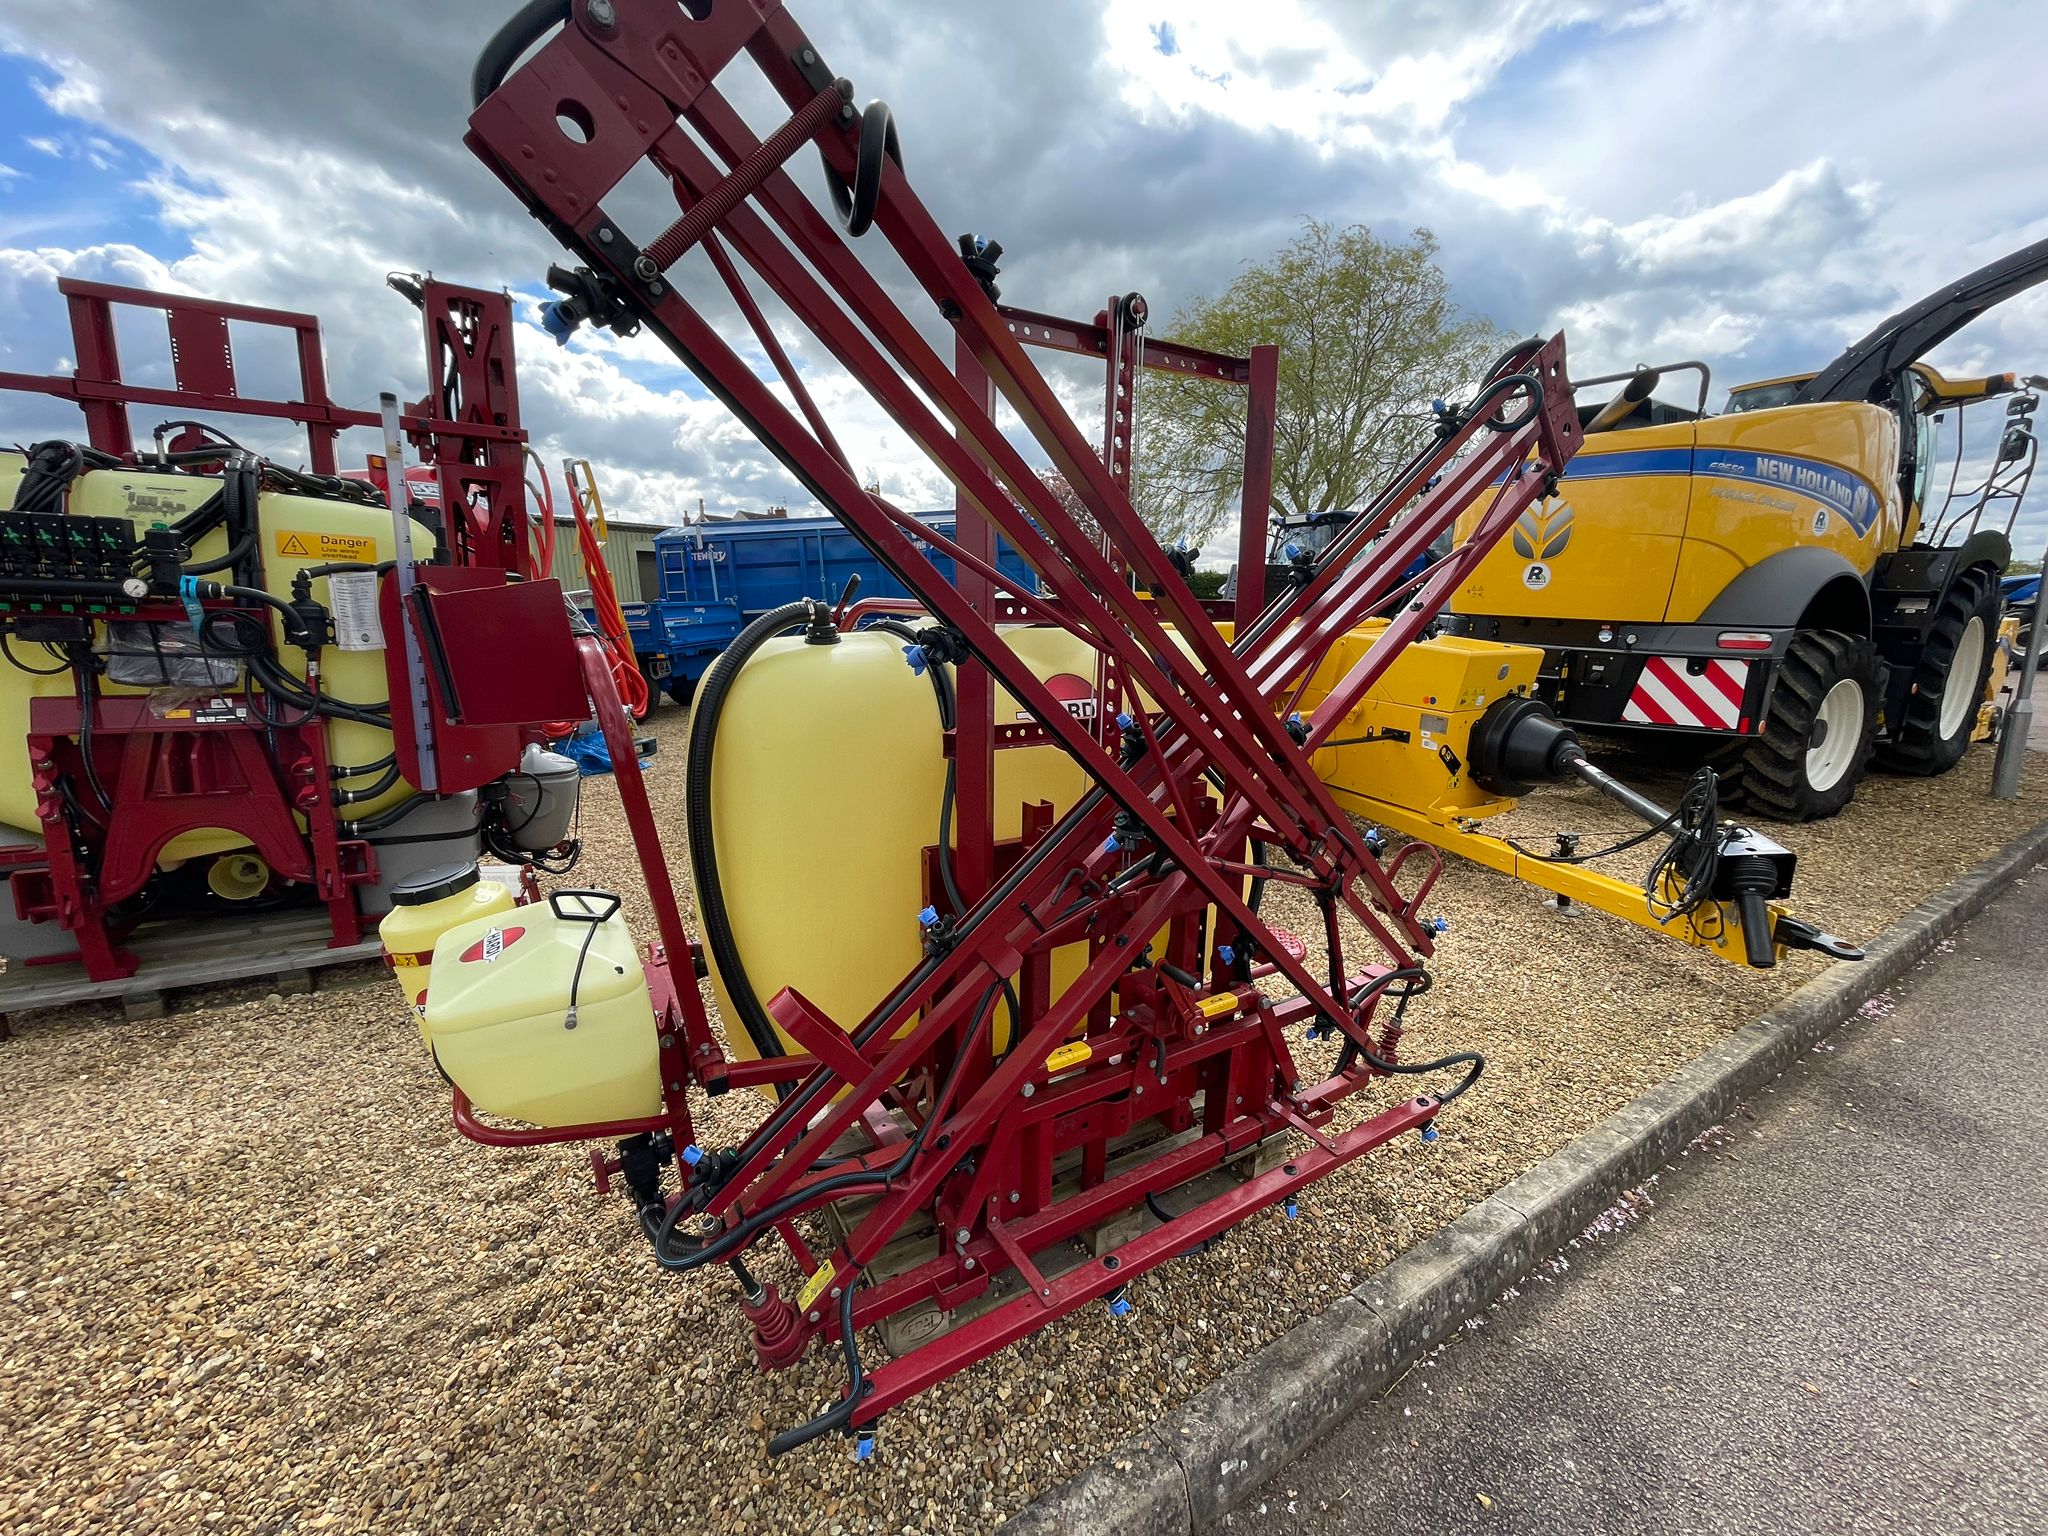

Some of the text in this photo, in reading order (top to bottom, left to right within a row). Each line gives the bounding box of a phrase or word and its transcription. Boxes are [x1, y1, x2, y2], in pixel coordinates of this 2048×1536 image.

[1756, 456, 1852, 507] NEW HOLLAND
[1815, 511, 1826, 526] R
[321, 535, 368, 548] Danger
[1528, 566, 1544, 580] R
[486, 931, 501, 958] HARDI
